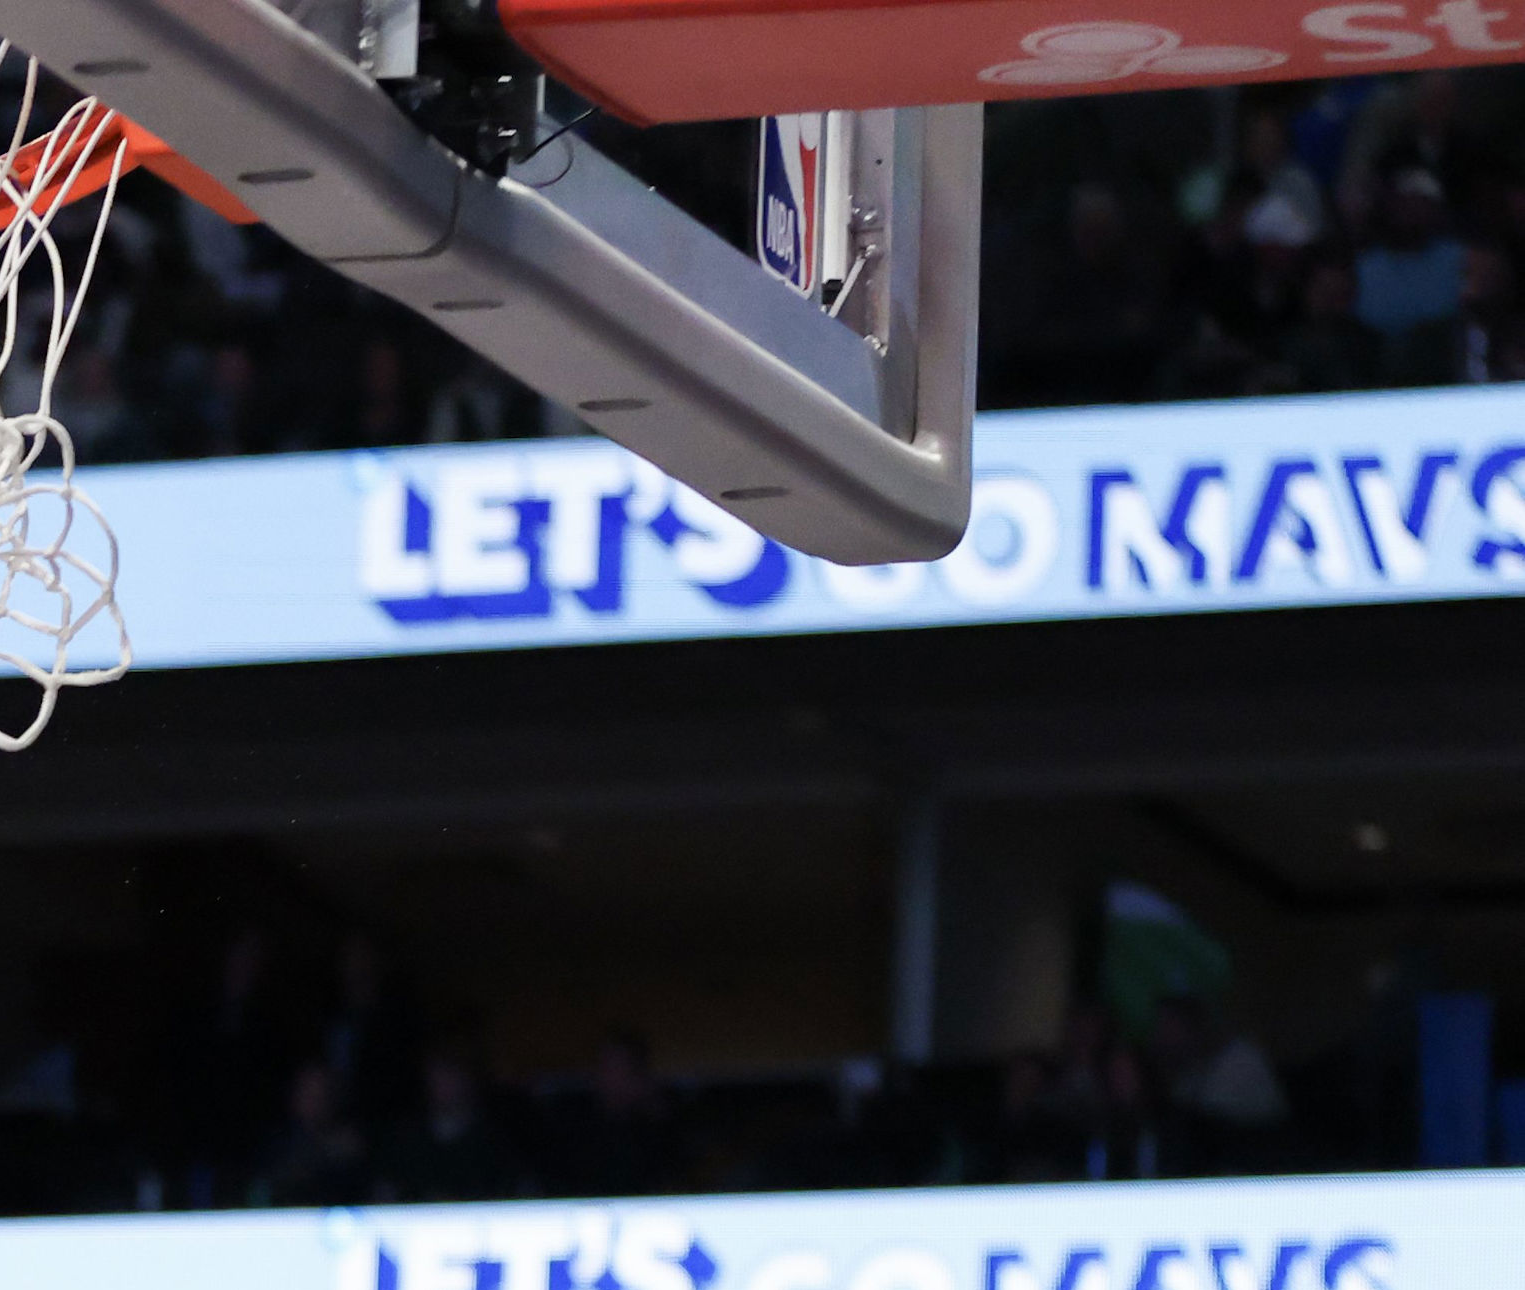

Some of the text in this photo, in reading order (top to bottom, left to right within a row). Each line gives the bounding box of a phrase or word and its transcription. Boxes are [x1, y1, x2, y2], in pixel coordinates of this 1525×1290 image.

[1302, 0, 1522, 62] St
[766, 194, 796, 266] NBA
[823, 478, 1059, 612] O
